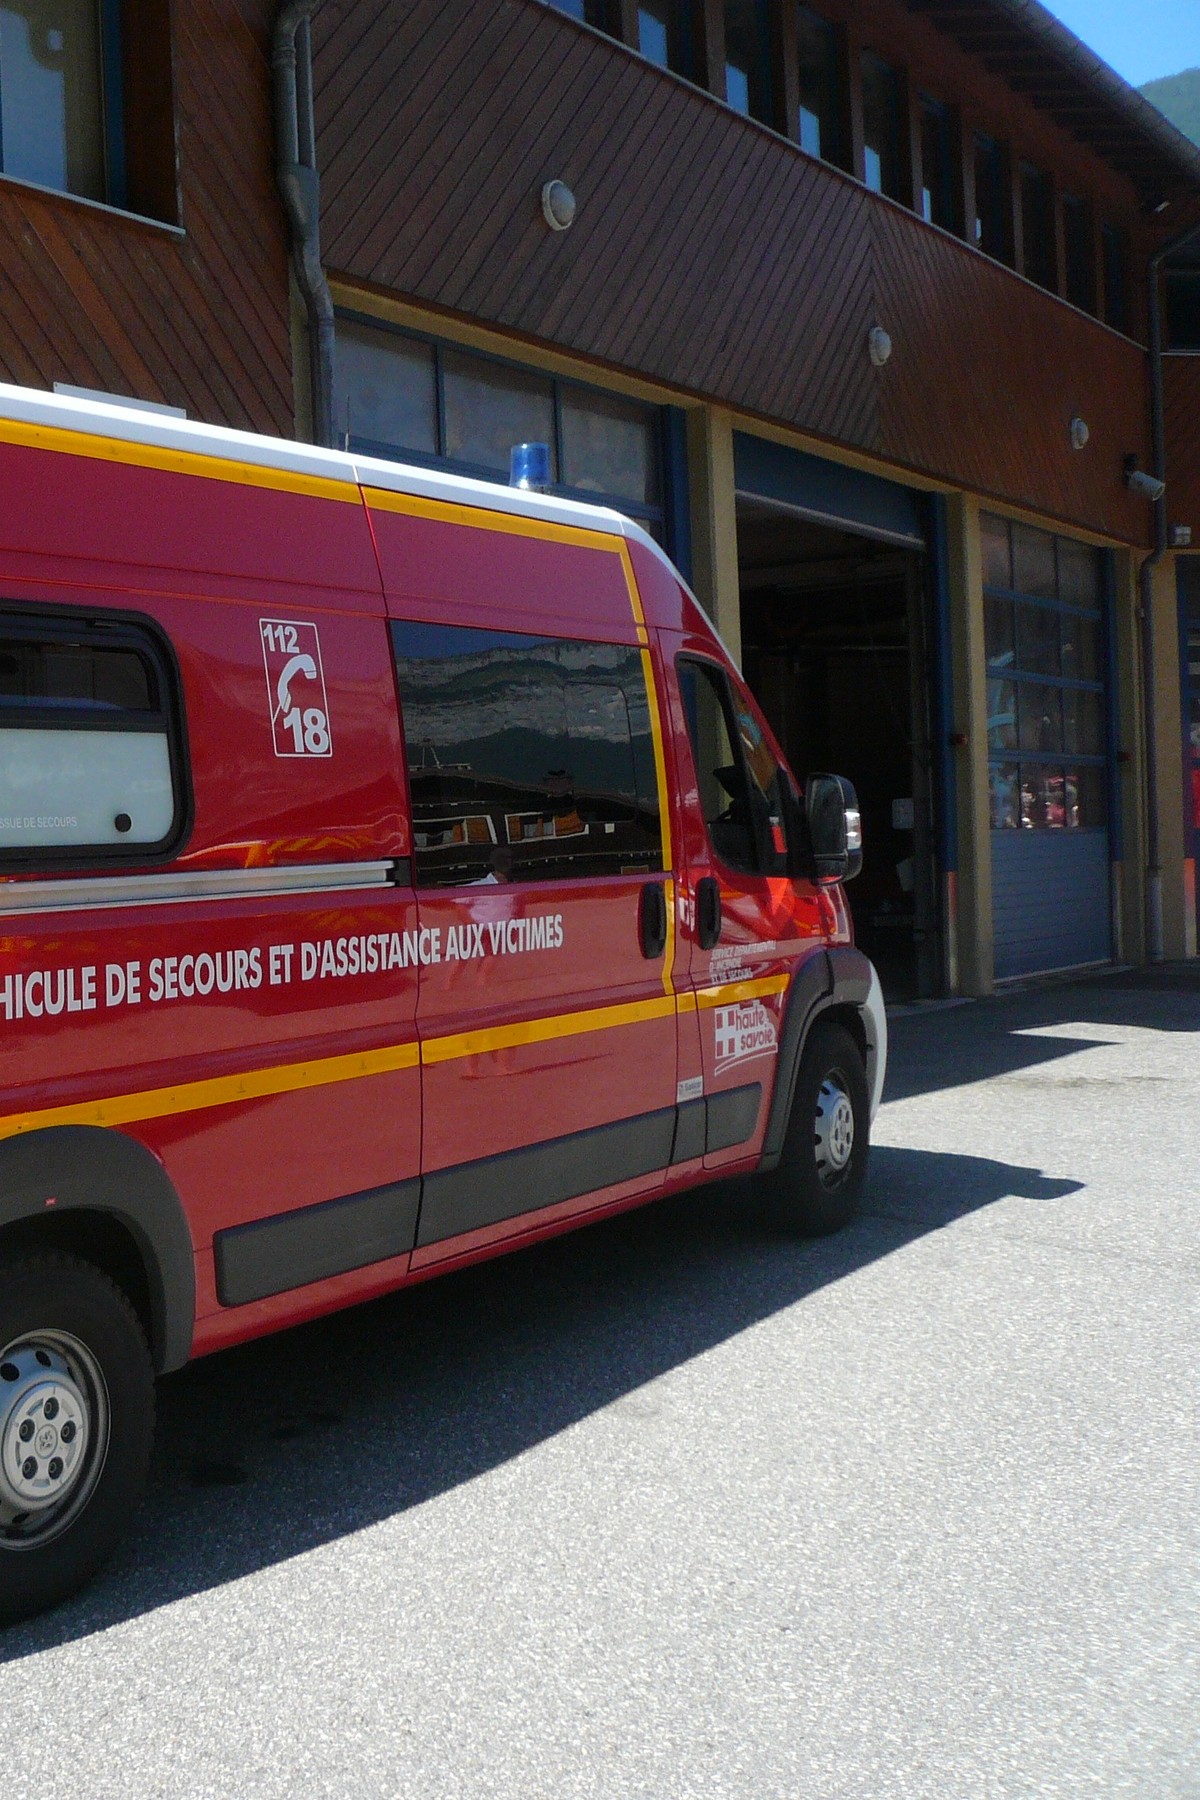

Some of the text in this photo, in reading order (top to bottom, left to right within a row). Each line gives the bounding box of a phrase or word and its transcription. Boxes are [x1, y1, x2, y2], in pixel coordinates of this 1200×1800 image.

[263, 624, 300, 653] 112
[283, 707, 329, 754] 18
[23, 817, 36, 829] DE
[37, 816, 78, 828] SECOURS
[106, 960, 141, 1006] DE
[148, 946, 262, 1000] SECOURS
[269, 944, 296, 984] ET
[300, 927, 440, 980] D'ASSISTANCE
[444, 922, 485, 961] AUX
[488, 914, 564, 955] VICTIMES
[735, 1005, 764, 1031] haute
[740, 1028, 773, 1051] savoie
